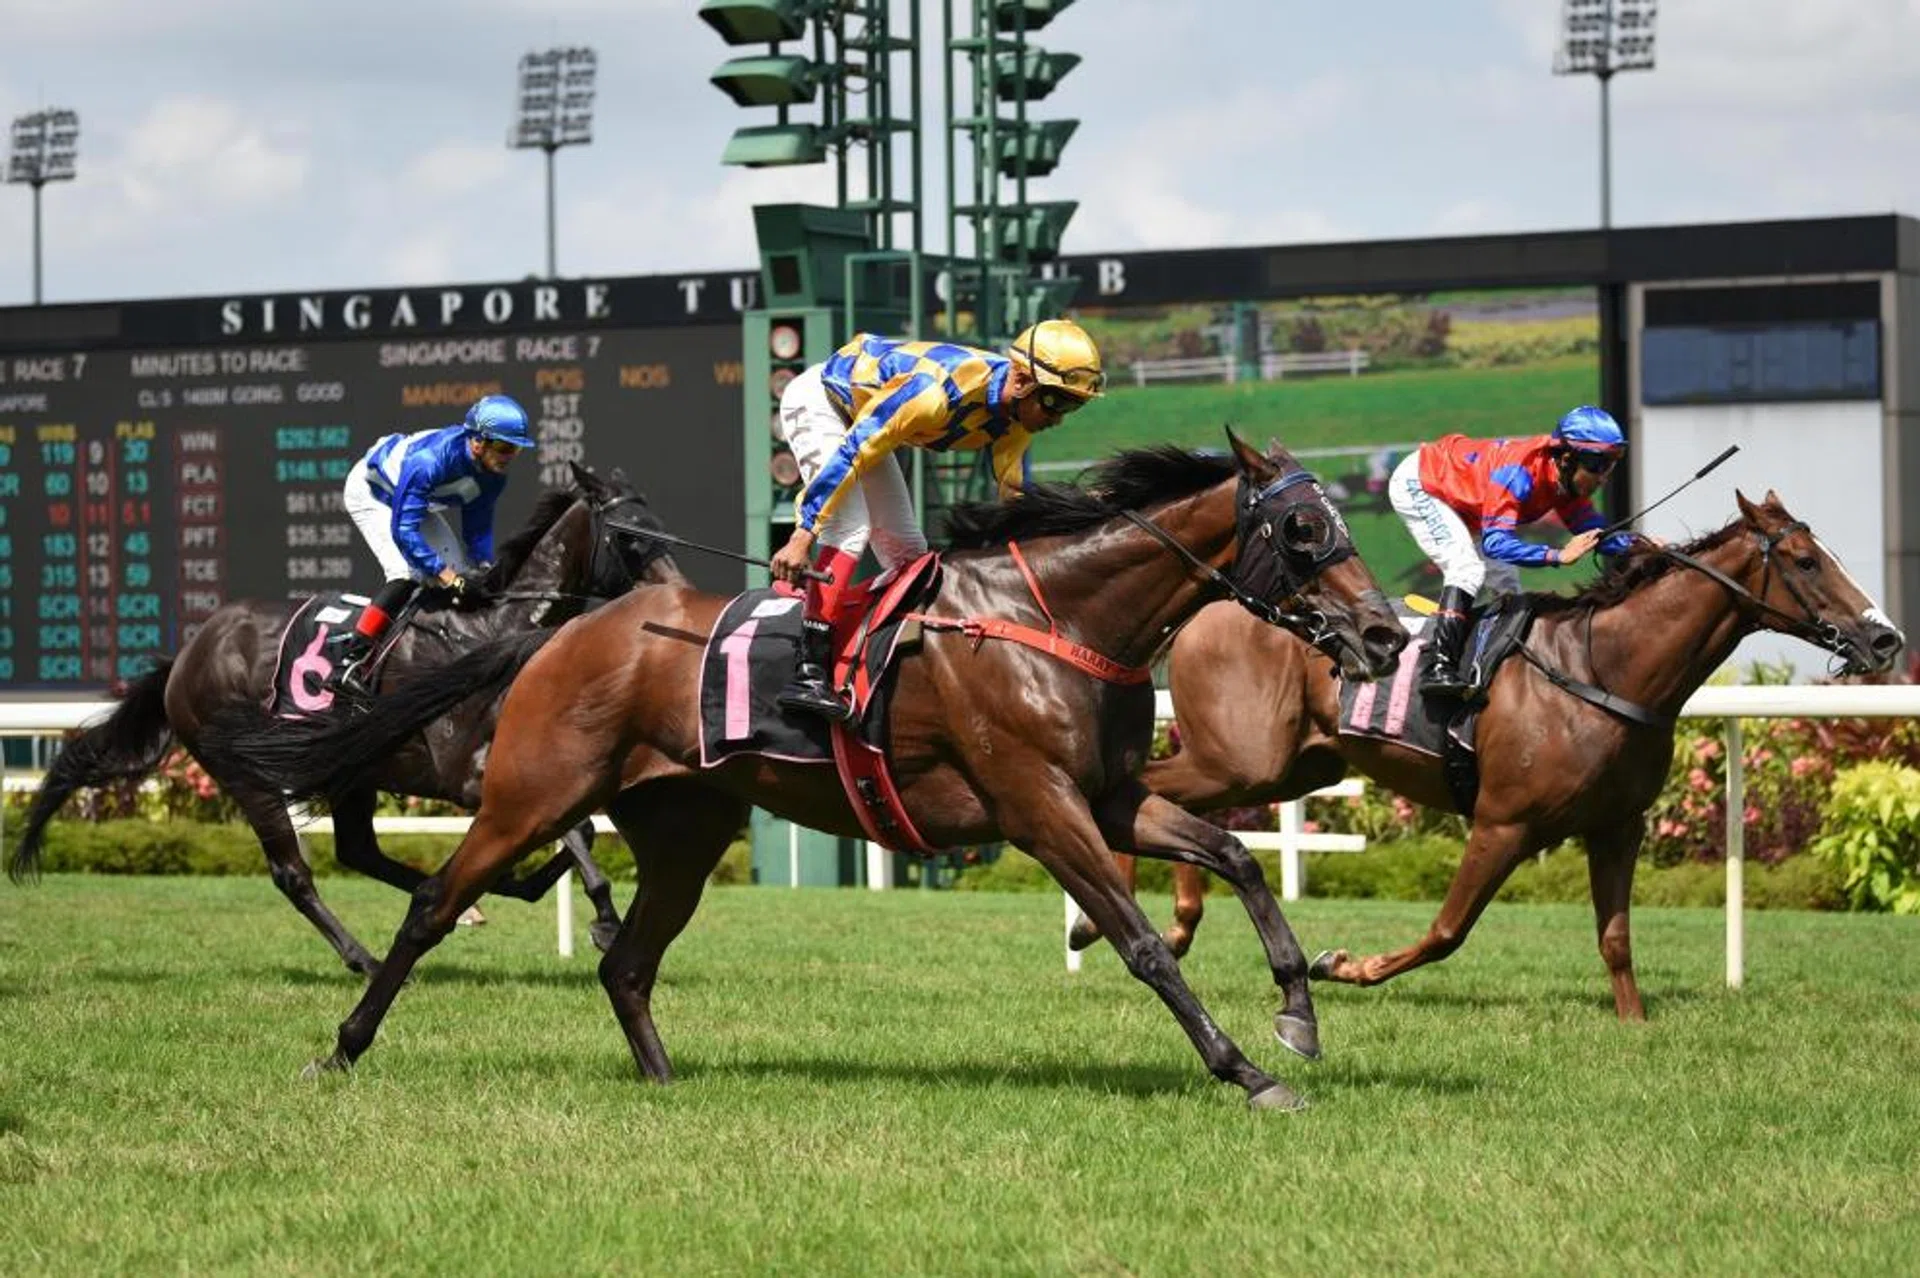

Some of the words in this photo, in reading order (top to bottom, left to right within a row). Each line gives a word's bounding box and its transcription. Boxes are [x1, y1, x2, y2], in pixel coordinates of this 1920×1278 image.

[221, 282, 610, 334] SINGAPORE
[677, 277, 756, 314] TU
[131, 352, 215, 377] MINUTES
[219, 351, 247, 374] TO
[379, 340, 506, 367] SINGAPORE
[516, 335, 578, 361] RACE
[585, 335, 601, 358] 7
[14, 357, 64, 382] RACE
[72, 353, 87, 379] 7
[619, 363, 671, 388] NOS
[296, 381, 345, 402] GOOD
[542, 395, 580, 416] 1ST
[180, 431, 217, 451] WIN
[538, 418, 584, 440] 2ND
[42, 442, 75, 466] 119
[88, 440, 104, 465] 9
[538, 441, 584, 463] 3RD
[87, 471, 109, 496] 10
[126, 469, 148, 494] 13
[181, 462, 217, 483] PLA
[182, 493, 216, 516] FCT
[87, 531, 110, 557] 12
[183, 525, 217, 548] PFT
[88, 562, 110, 588] 13
[183, 557, 218, 582] TCE
[38, 593, 81, 619] SCR
[117, 592, 160, 619] SCR
[39, 624, 82, 649] SCR
[117, 623, 161, 648] SCR
[39, 655, 82, 680] SCR
[290, 623, 335, 711] 6
[720, 618, 760, 741] 1
